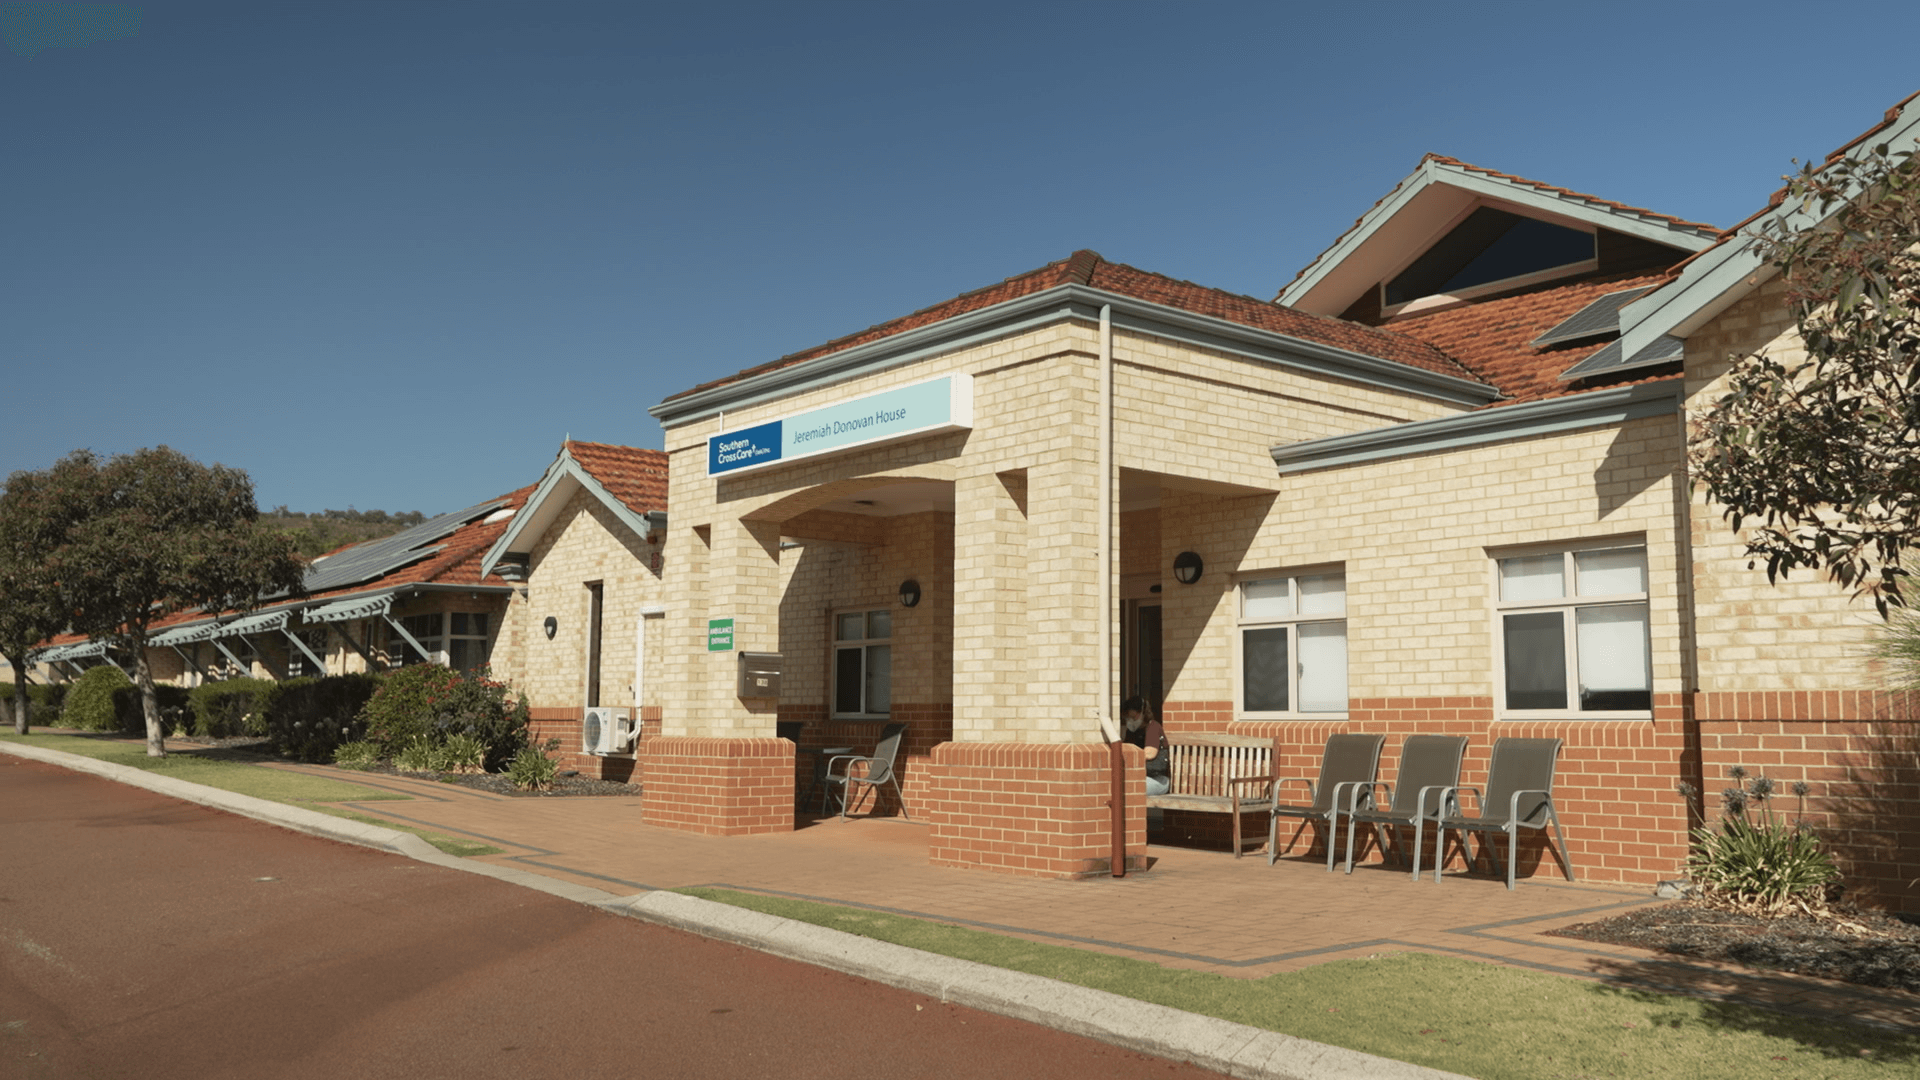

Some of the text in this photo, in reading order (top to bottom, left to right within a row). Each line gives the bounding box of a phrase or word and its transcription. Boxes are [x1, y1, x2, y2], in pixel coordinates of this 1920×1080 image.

[793, 408, 906, 444] Jeremiah Donovan House
[718, 439, 750, 453] Southern
[718, 453, 736, 464] Cross
[736, 449, 752, 460] Care
